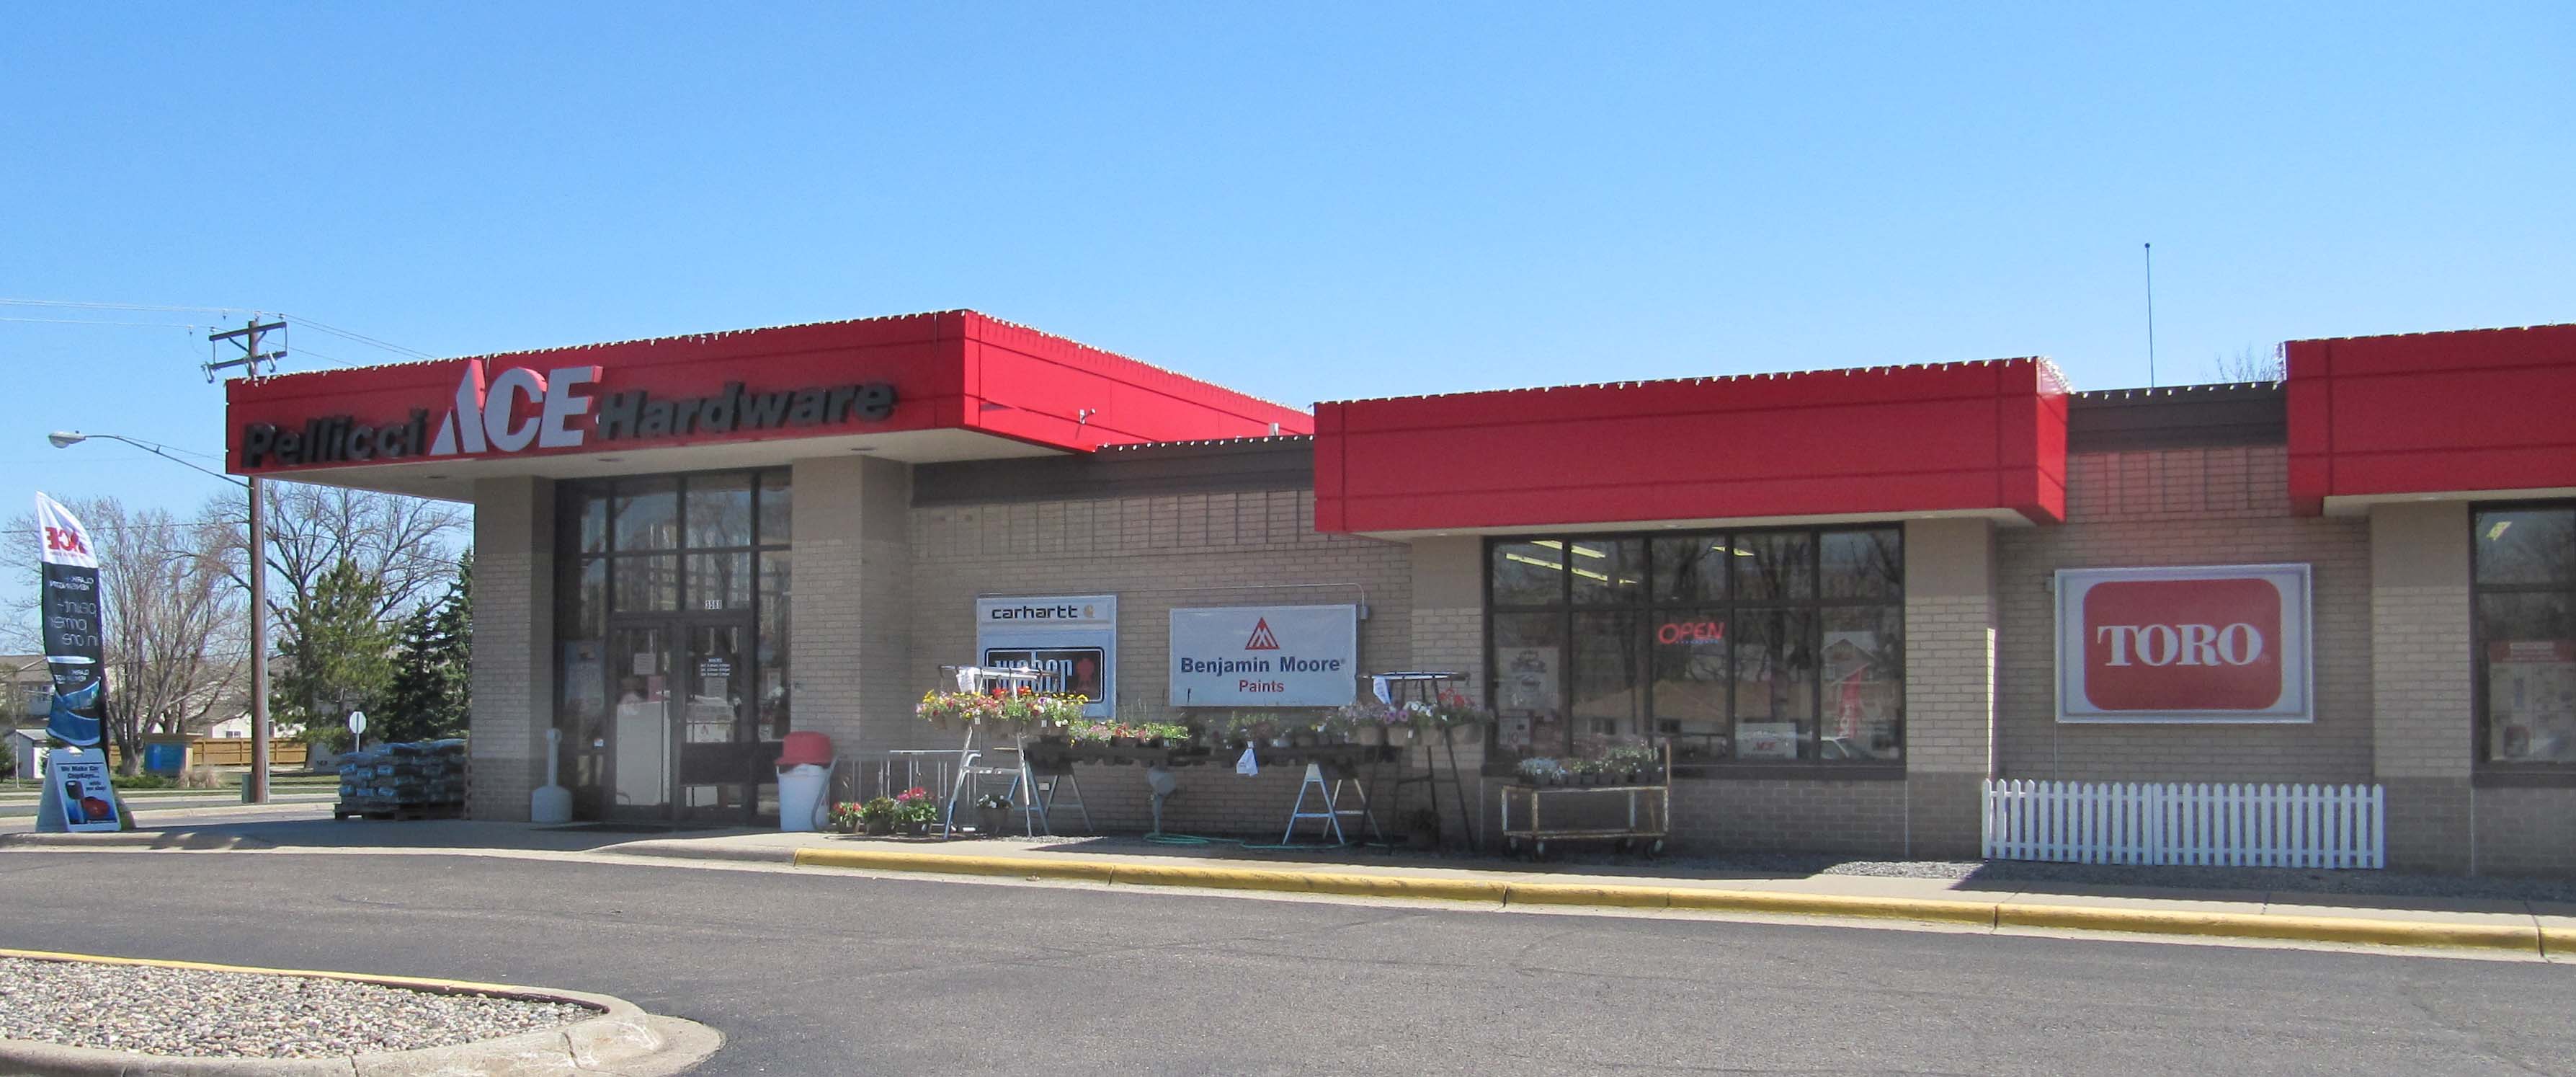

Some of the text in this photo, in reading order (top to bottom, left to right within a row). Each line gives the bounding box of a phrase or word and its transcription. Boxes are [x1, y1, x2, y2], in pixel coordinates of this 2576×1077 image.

[241, 359, 899, 467] Pellicci ACE Hardware
[991, 606, 1078, 619] carhartt
[1659, 622, 1724, 644] OPEN
[2098, 623, 2263, 666] TORO
[1180, 656, 1341, 677] Benjamin Moore
[1239, 679, 1285, 693] Paints
